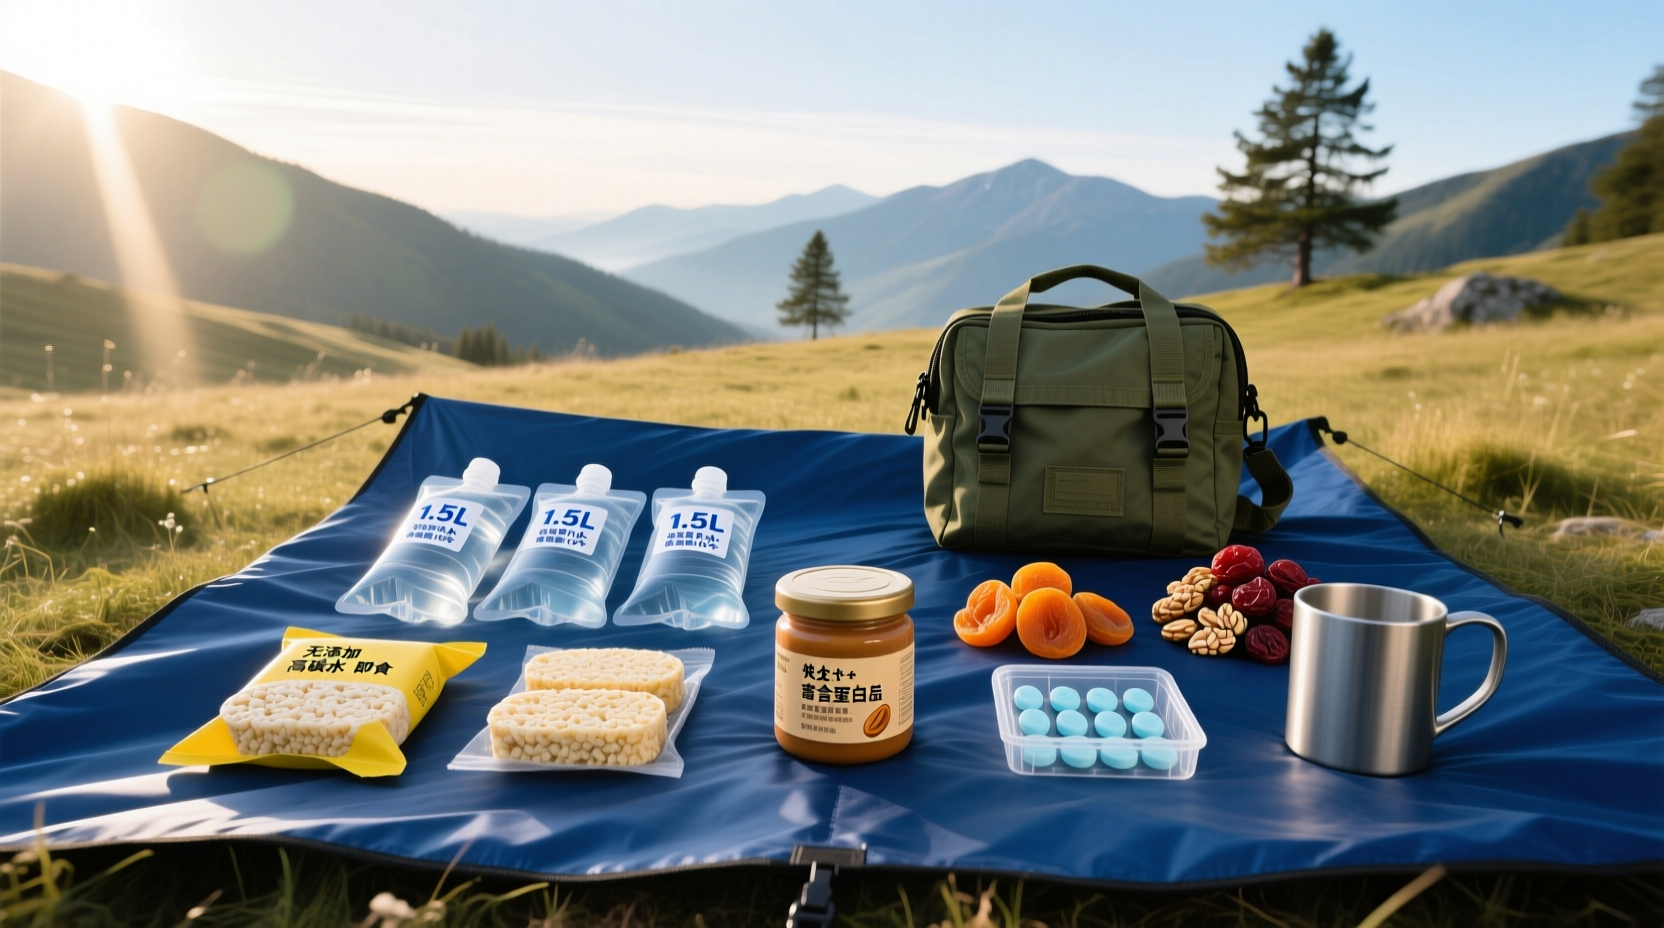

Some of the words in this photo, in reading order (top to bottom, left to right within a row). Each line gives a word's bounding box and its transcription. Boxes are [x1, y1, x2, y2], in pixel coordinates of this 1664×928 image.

[420, 503, 467, 527] 1.5L
[543, 509, 594, 530] 1.5L
[671, 511, 724, 533] 1.5L
